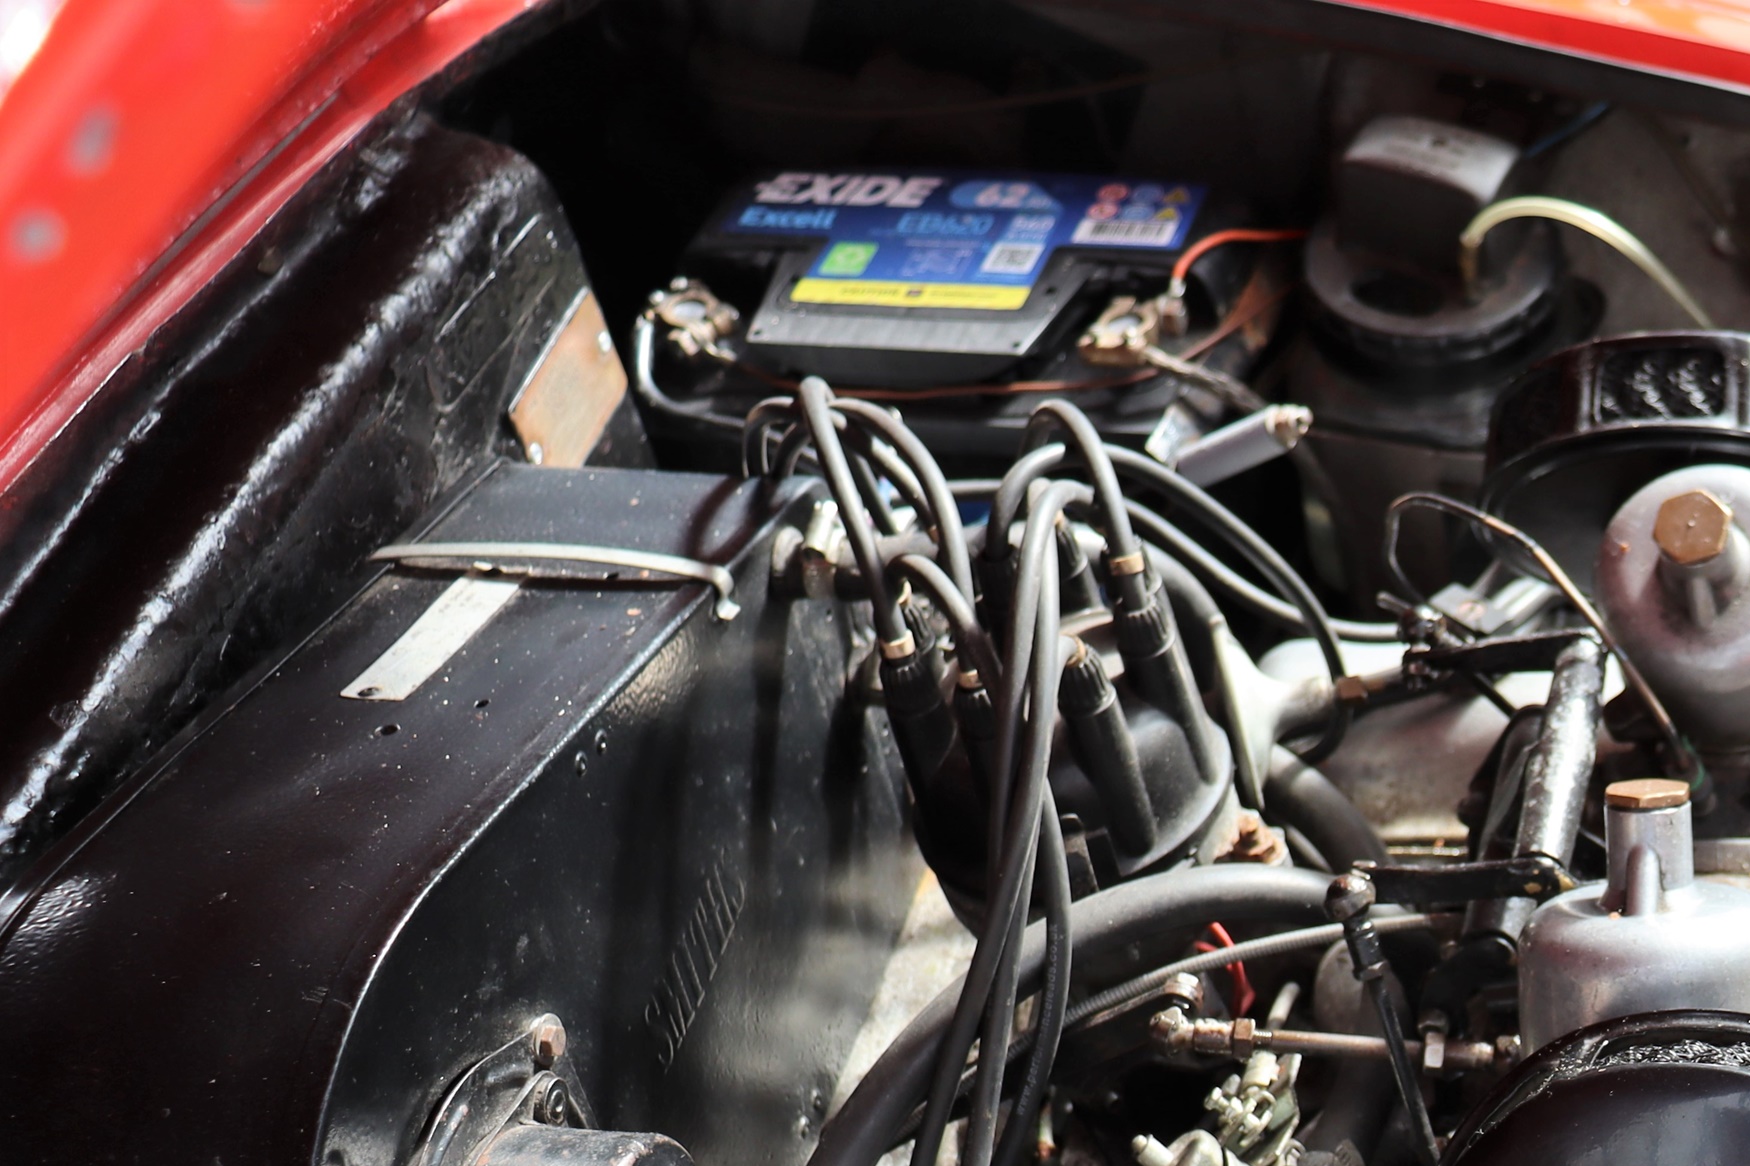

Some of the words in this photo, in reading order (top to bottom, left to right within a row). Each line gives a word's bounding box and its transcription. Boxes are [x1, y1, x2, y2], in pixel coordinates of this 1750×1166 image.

[754, 172, 943, 208] EXIDE
[738, 206, 838, 229] Excell
[645, 848, 746, 1074] SMITHS
